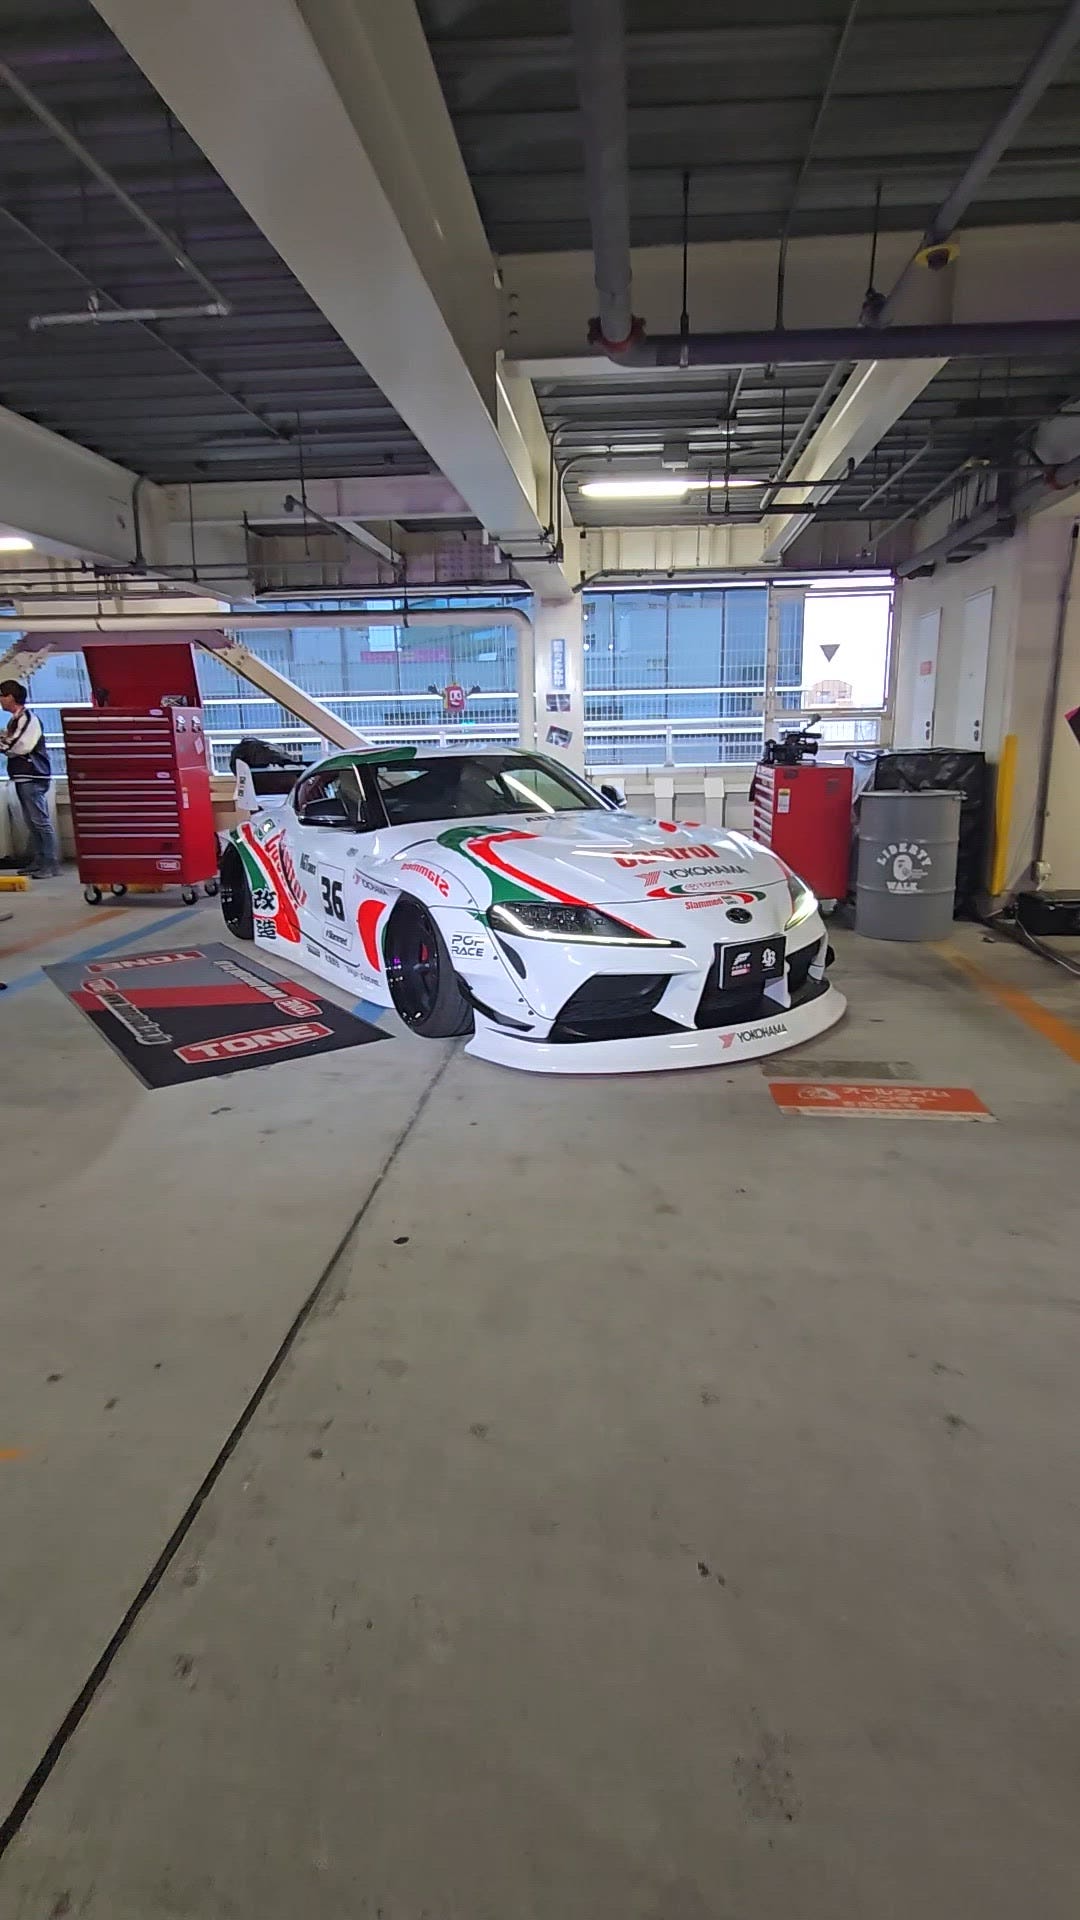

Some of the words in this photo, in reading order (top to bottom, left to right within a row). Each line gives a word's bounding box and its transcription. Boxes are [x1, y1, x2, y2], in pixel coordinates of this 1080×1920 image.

[876, 842, 932, 866] LIBERTY
[662, 865, 749, 879] YOKOHAMA
[886, 881, 918, 891] WALK
[321, 876, 345, 922] 36
[451, 946, 484, 957] RACE
[191, 1026, 319, 1057] TONE
[737, 1023, 788, 1043] YOKOHAMA
